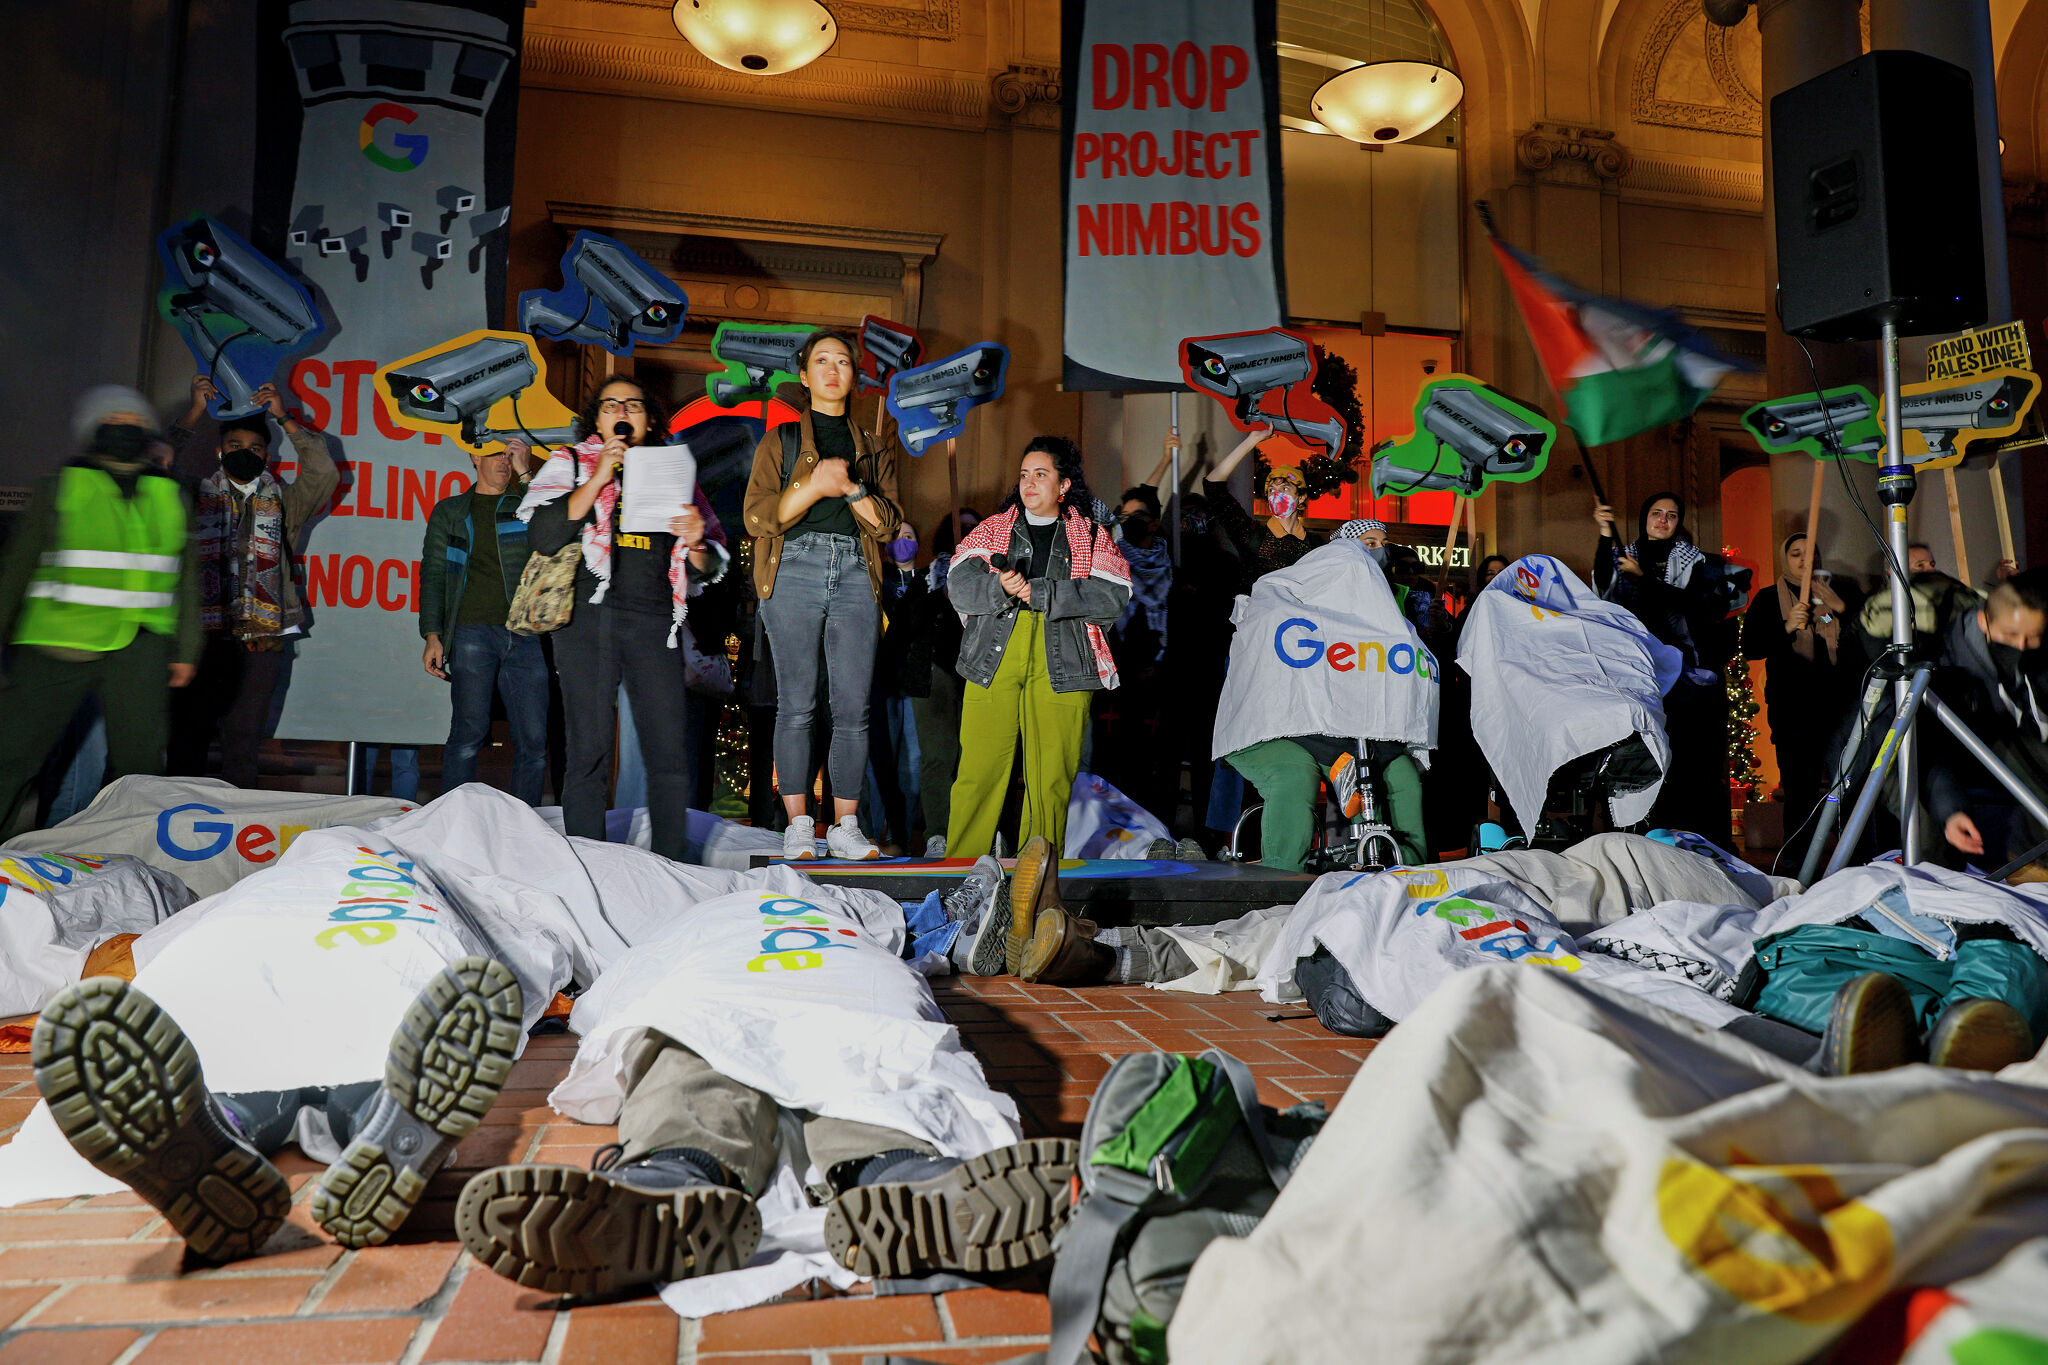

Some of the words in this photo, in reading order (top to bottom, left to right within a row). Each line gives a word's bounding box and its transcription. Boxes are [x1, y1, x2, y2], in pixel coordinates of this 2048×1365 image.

[1092, 40, 1249, 112] DROP
[1075, 129, 1260, 180] PROJECT
[1077, 201, 1262, 258] NIMBUS
[725, 334, 757, 345] PROJECT
[759, 336, 796, 348] NIMBUS
[1229, 358, 1268, 371] PROJECT
[1270, 351, 1305, 363] NIMBUS
[1928, 337, 1974, 363] STAND
[1976, 325, 2021, 351] WITH
[1928, 341, 2025, 381] PALESTINE!
[441, 369, 486, 394] PROJECT
[488, 352, 525, 374] NIMBUS
[932, 363, 969, 380] NIMBUS
[288, 359, 442, 445] ST
[1433, 400, 1472, 426] PROJECT
[1901, 398, 1932, 409] OJECT
[1935, 390, 1983, 405] NIMBUS
[1397, 544, 1470, 567] RKET
[1274, 617, 1440, 684] Genoc
[315, 847, 438, 950] nocide
[746, 894, 857, 972] ocide
